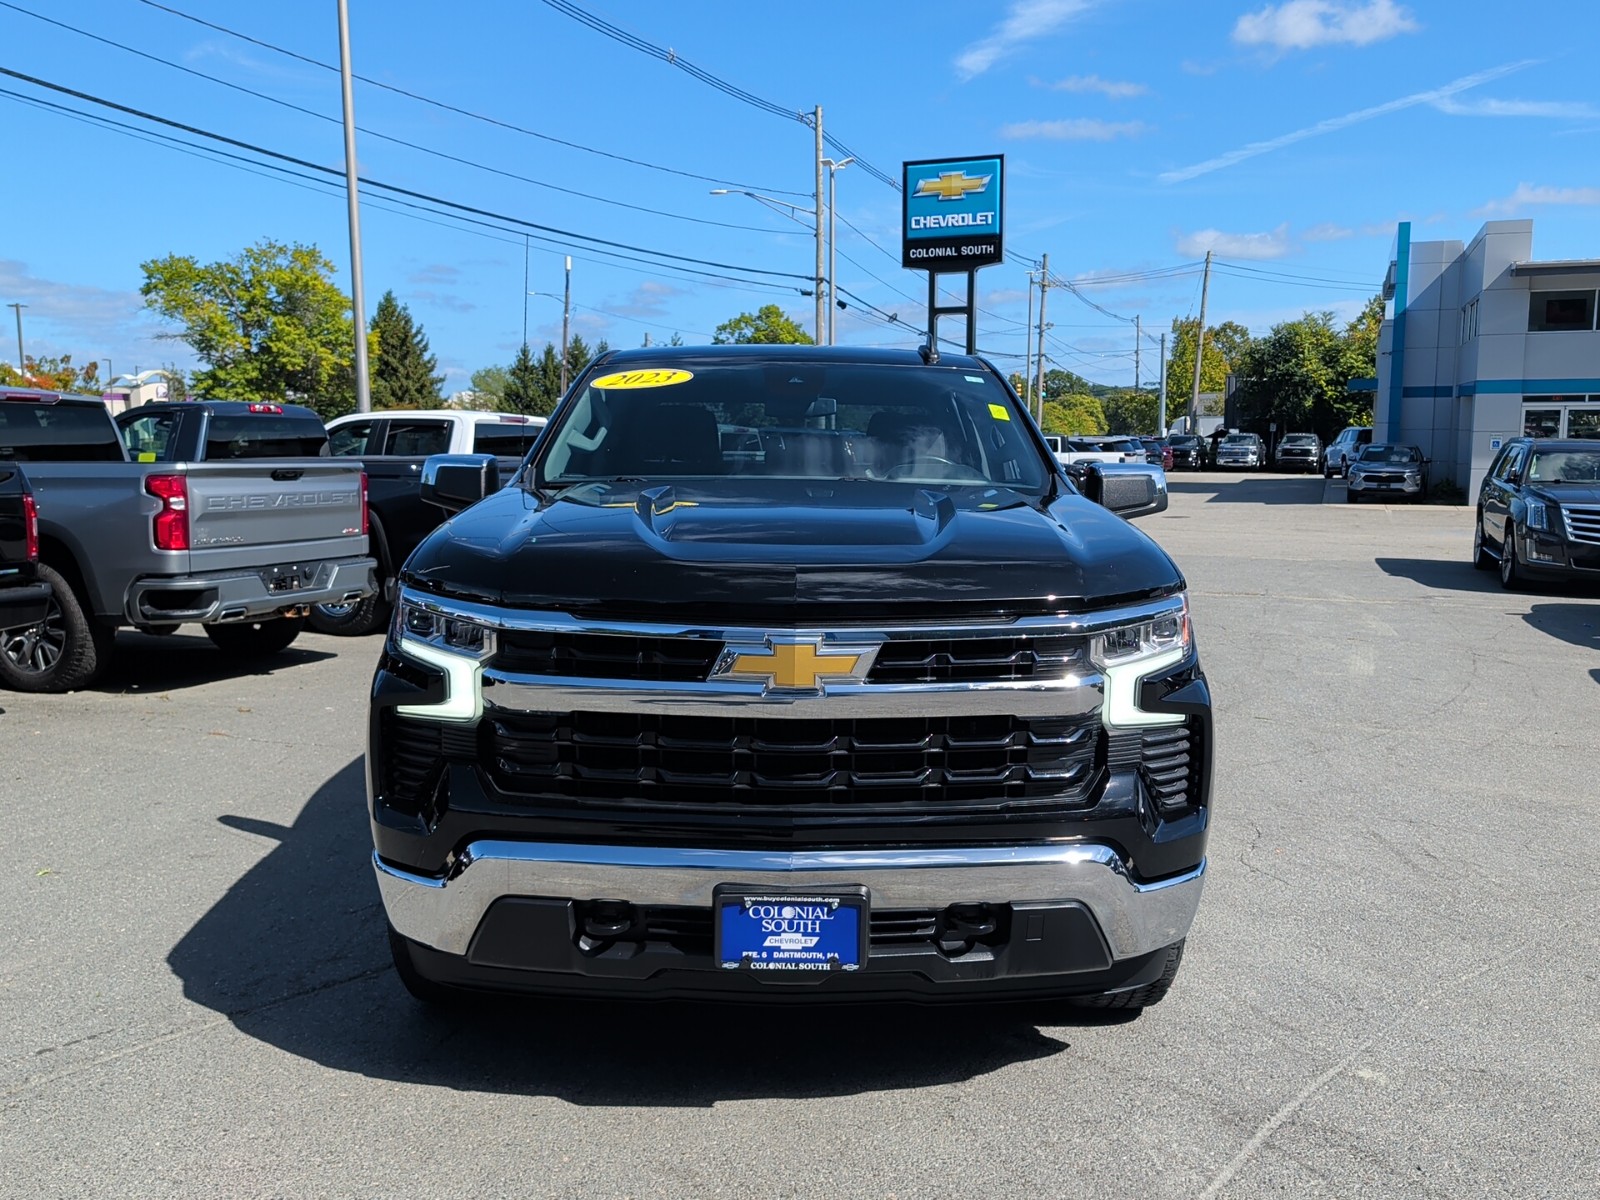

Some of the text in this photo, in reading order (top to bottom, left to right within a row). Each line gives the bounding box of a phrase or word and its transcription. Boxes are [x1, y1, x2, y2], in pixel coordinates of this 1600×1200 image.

[911, 212, 995, 229] CHEVROLET
[909, 245, 994, 258] COLONIAL SOUTH
[605, 372, 677, 386] 2023
[207, 493, 357, 510] CHEVROLET
[749, 906, 834, 920] COLONIAL
[762, 920, 820, 933] SOUTH
[773, 951, 825, 960] DARTMOUTH,
[750, 962, 797, 970] COLONIAL
